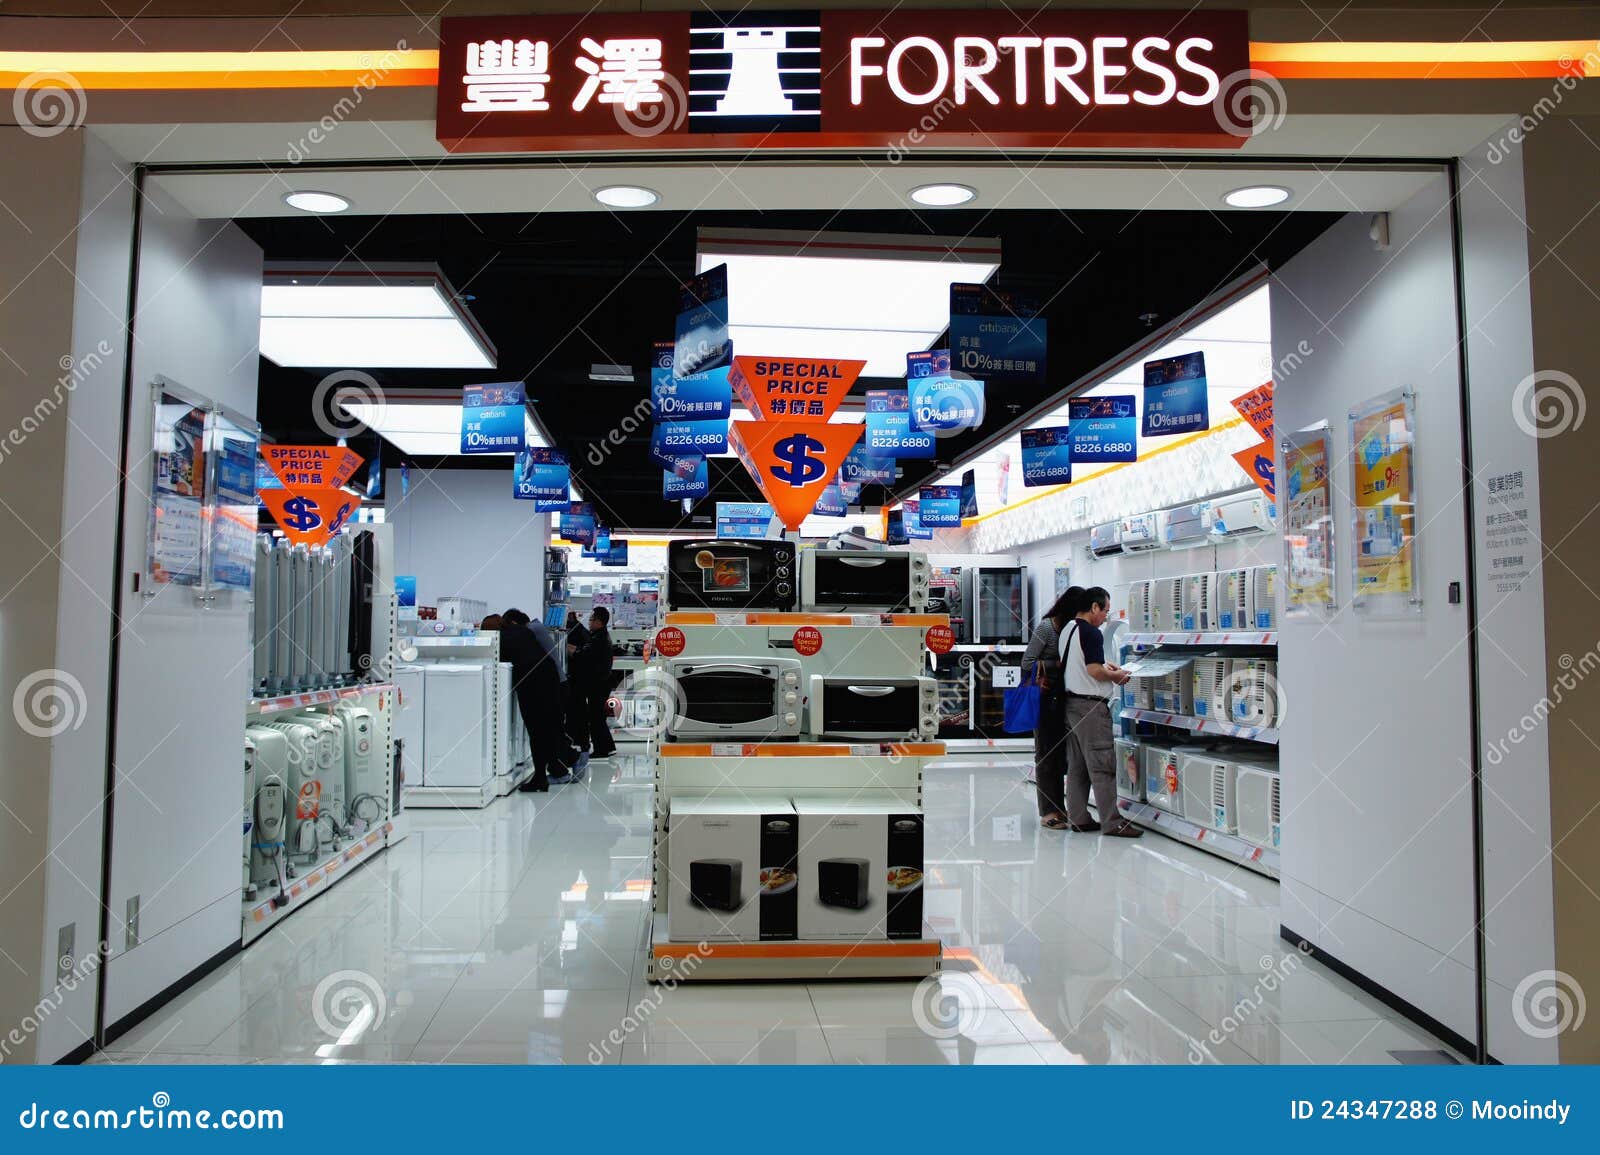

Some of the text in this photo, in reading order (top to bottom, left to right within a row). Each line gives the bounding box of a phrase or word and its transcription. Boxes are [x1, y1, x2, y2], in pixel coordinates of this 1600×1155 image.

[461, 38, 665, 112] 豐澤
[850, 36, 1220, 106] FORTRESS
[755, 361, 842, 379] SPECIAL
[766, 379, 828, 395] PRICE
[770, 399, 823, 415] 特價品
[665, 434, 723, 445] 8226 6880
[872, 437, 930, 448] 8226 6880
[1074, 442, 1132, 453] 8226 6880
[271, 448, 330, 459] SPECIAL
[281, 460, 323, 470] PRICE
[770, 433, 827, 488] $
[1026, 467, 1068, 478] 8226 6880
[667, 481, 705, 492] 8226 6880
